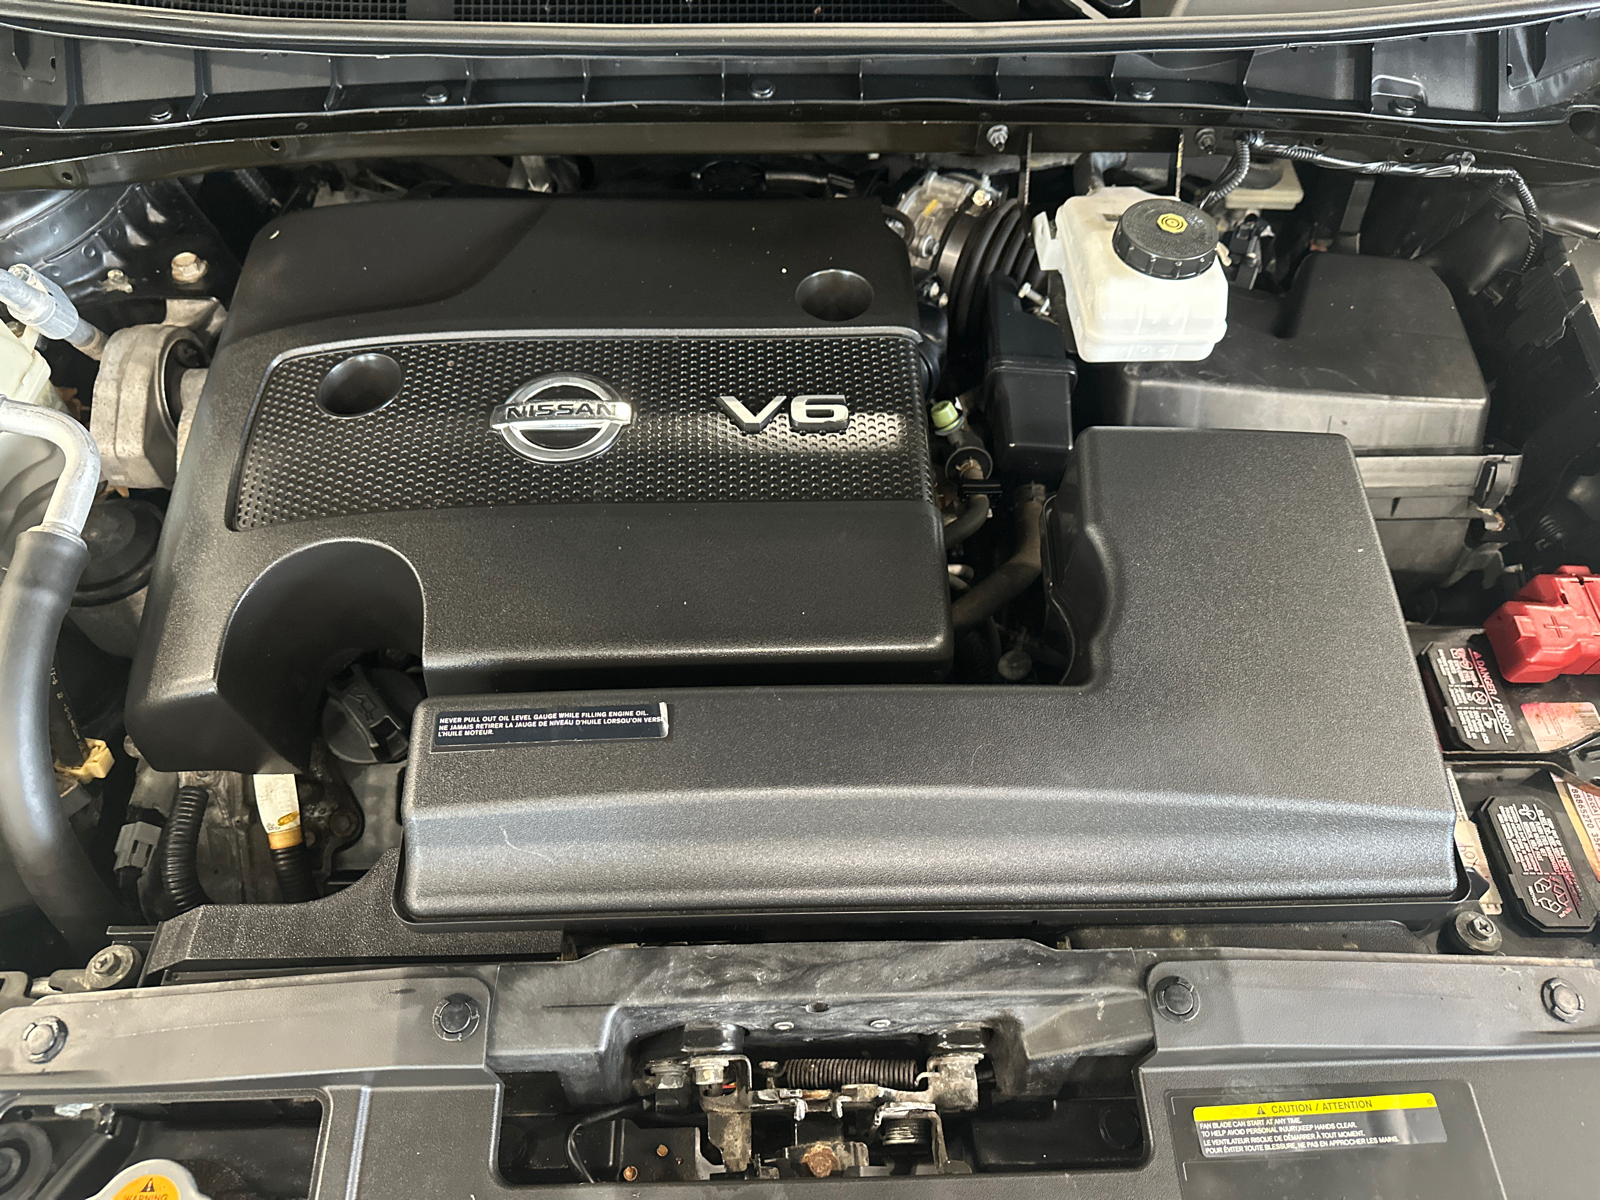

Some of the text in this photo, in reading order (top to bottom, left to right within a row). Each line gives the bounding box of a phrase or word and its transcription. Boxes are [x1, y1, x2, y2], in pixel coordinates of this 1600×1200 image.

[506, 402, 615, 418] NISSAN
[717, 394, 850, 432] V6
[1476, 660, 1498, 695] DANGER
[1494, 703, 1515, 736] POISON
[1271, 1100, 1372, 1114] CAUTION / ATTENTION
[1246, 1126, 1278, 1134] PERSONAL
[1212, 1138, 1250, 1146] VENTILATEUR
[1329, 1138, 1366, 1146] APPROCHER
